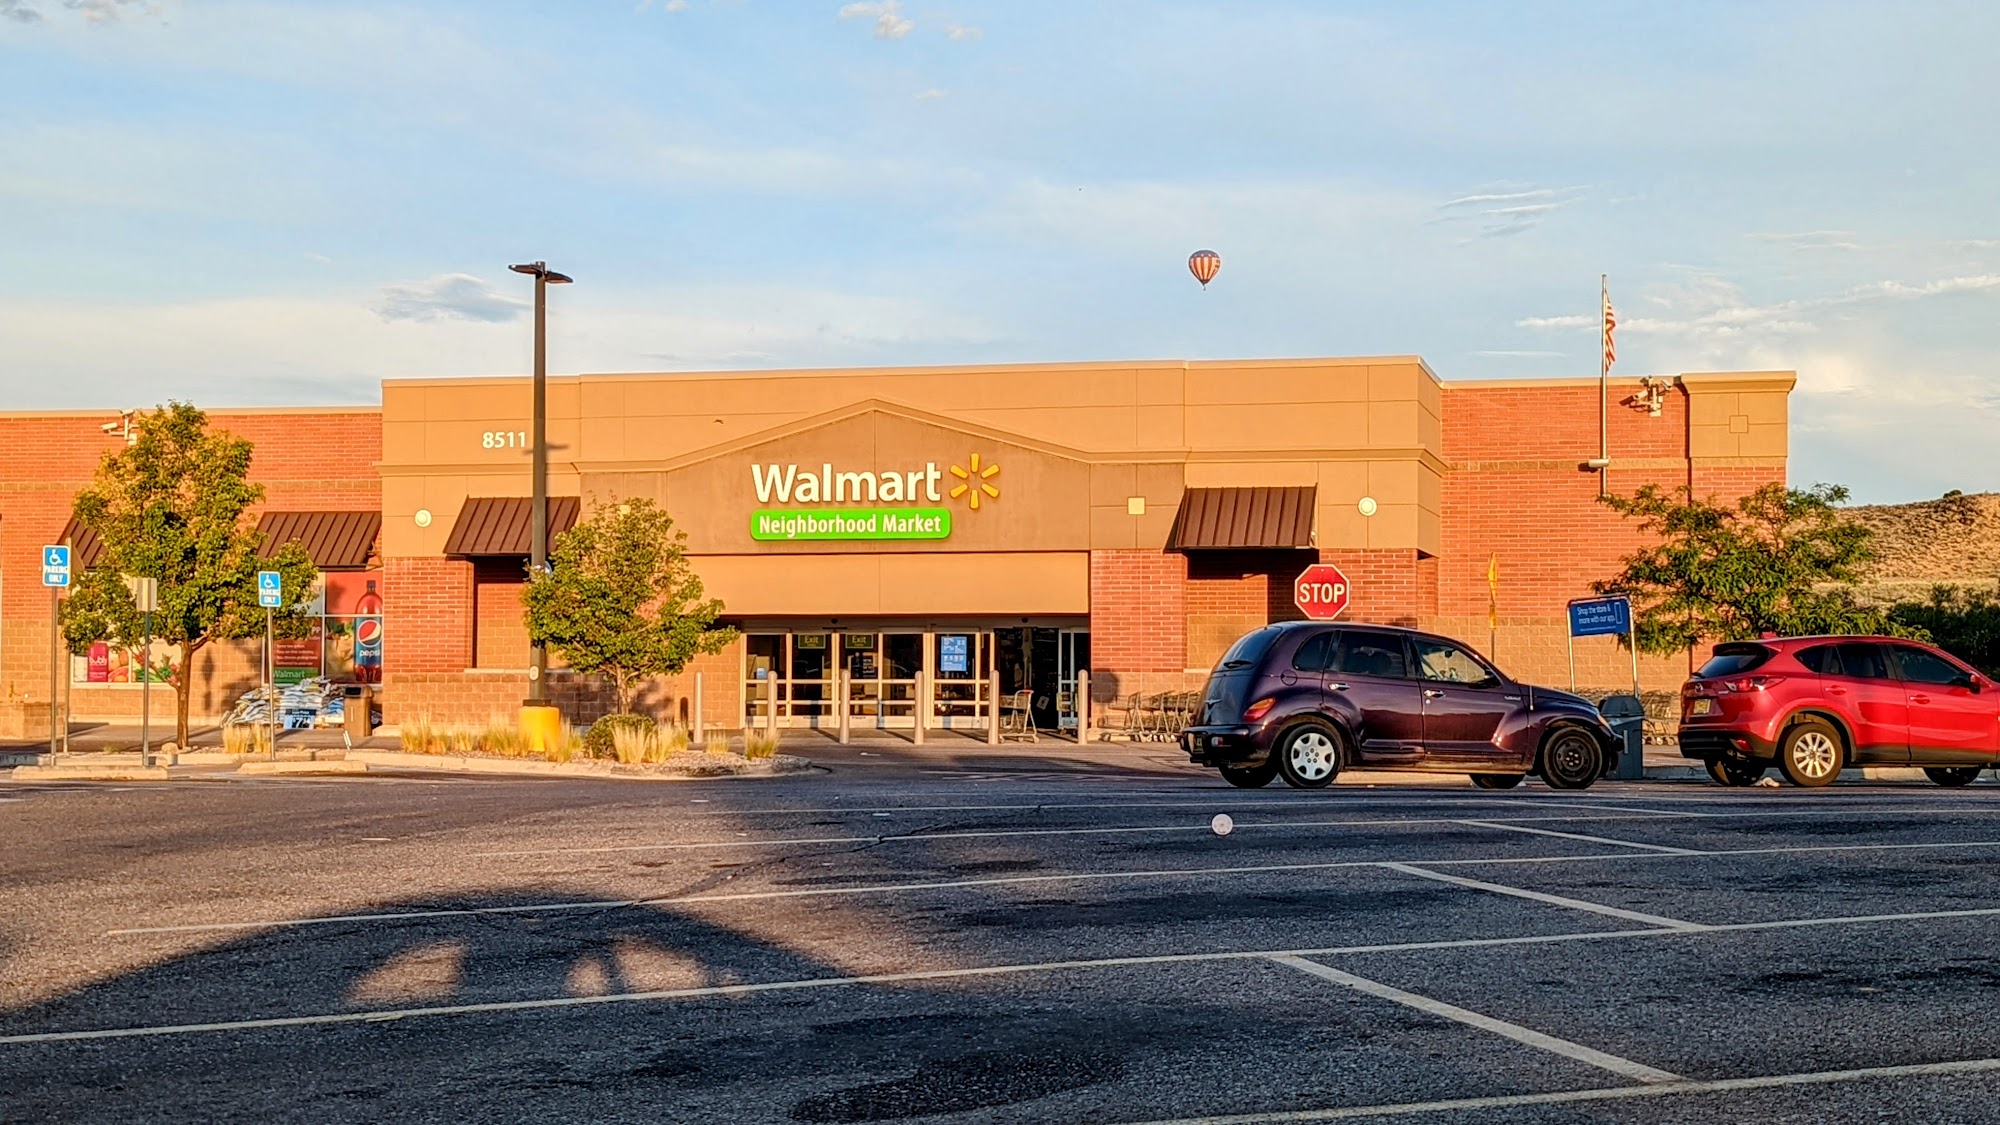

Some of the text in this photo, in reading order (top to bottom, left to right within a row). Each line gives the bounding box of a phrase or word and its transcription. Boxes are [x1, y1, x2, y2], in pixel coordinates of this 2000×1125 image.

[482, 431, 526, 449] 8511
[751, 462, 942, 503] Walmart
[759, 514, 942, 538] Neighborhood Market
[48, 573, 64, 583] ONLY
[264, 595, 277, 604] ONLY
[1299, 583, 1345, 604] STOP
[804, 635, 819, 644] Exit
[852, 635, 867, 644] Exit
